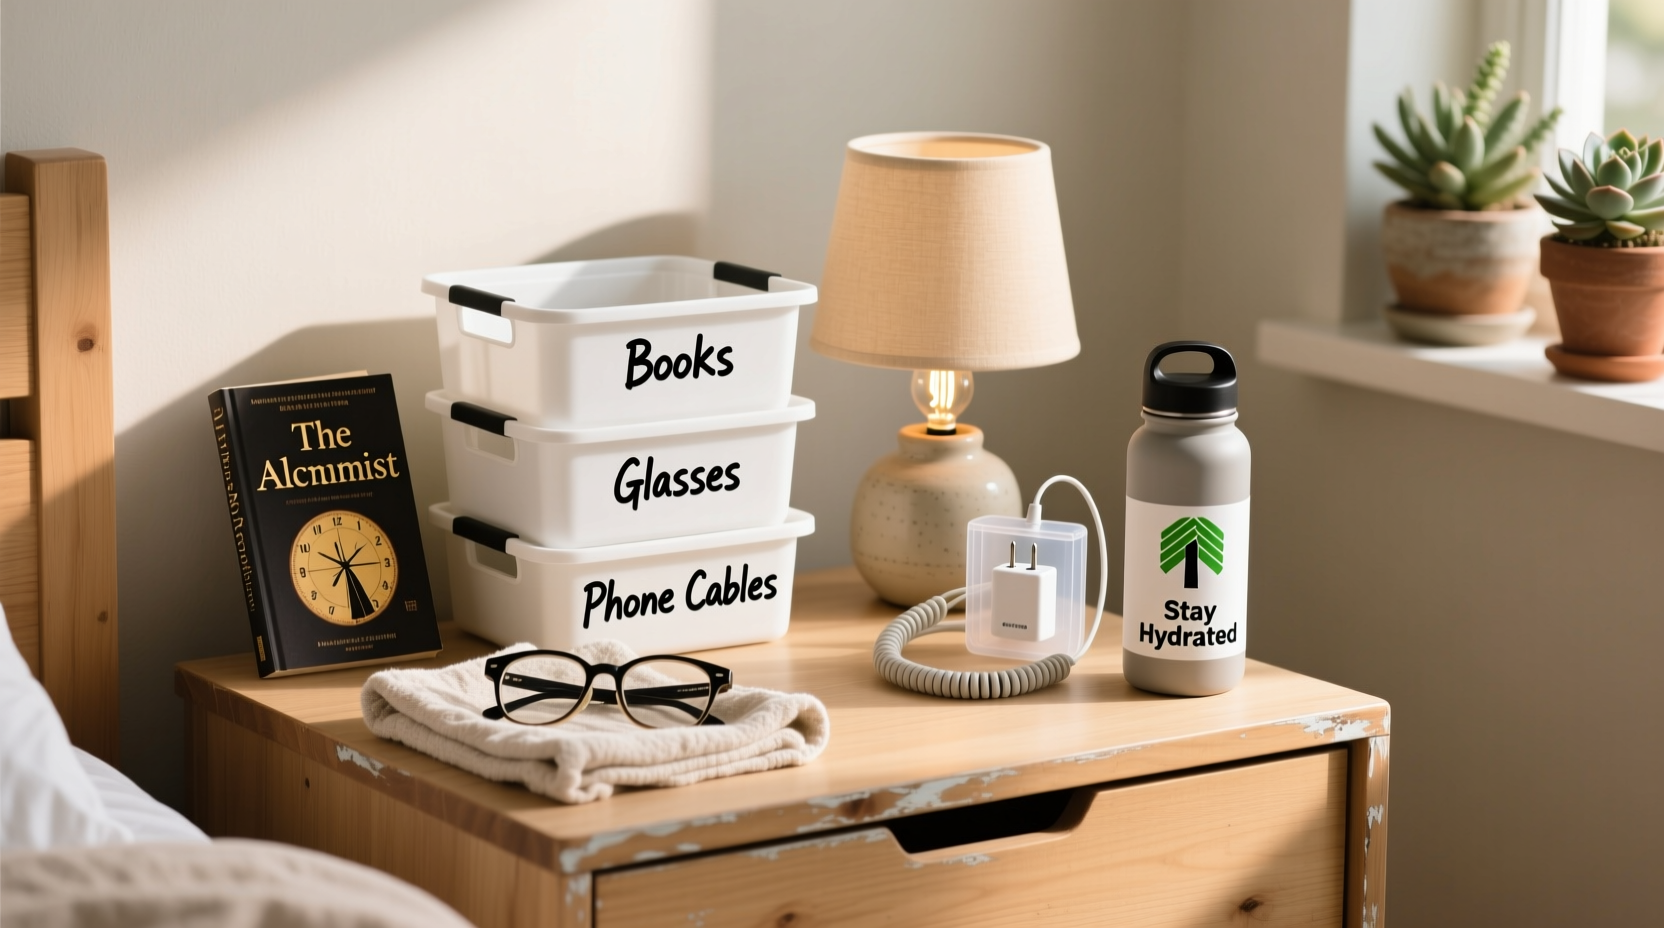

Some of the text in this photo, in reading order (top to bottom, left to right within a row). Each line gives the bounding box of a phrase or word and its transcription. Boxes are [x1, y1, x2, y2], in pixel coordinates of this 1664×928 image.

[624, 333, 734, 391] Books
[291, 420, 352, 451] The
[613, 455, 741, 511] Glasses
[375, 535, 382, 546] 2
[384, 557, 391, 568] 3
[582, 563, 778, 630] Phone Cables
[1164, 599, 1217, 626] Stay
[1139, 621, 1237, 651] Hydrated
